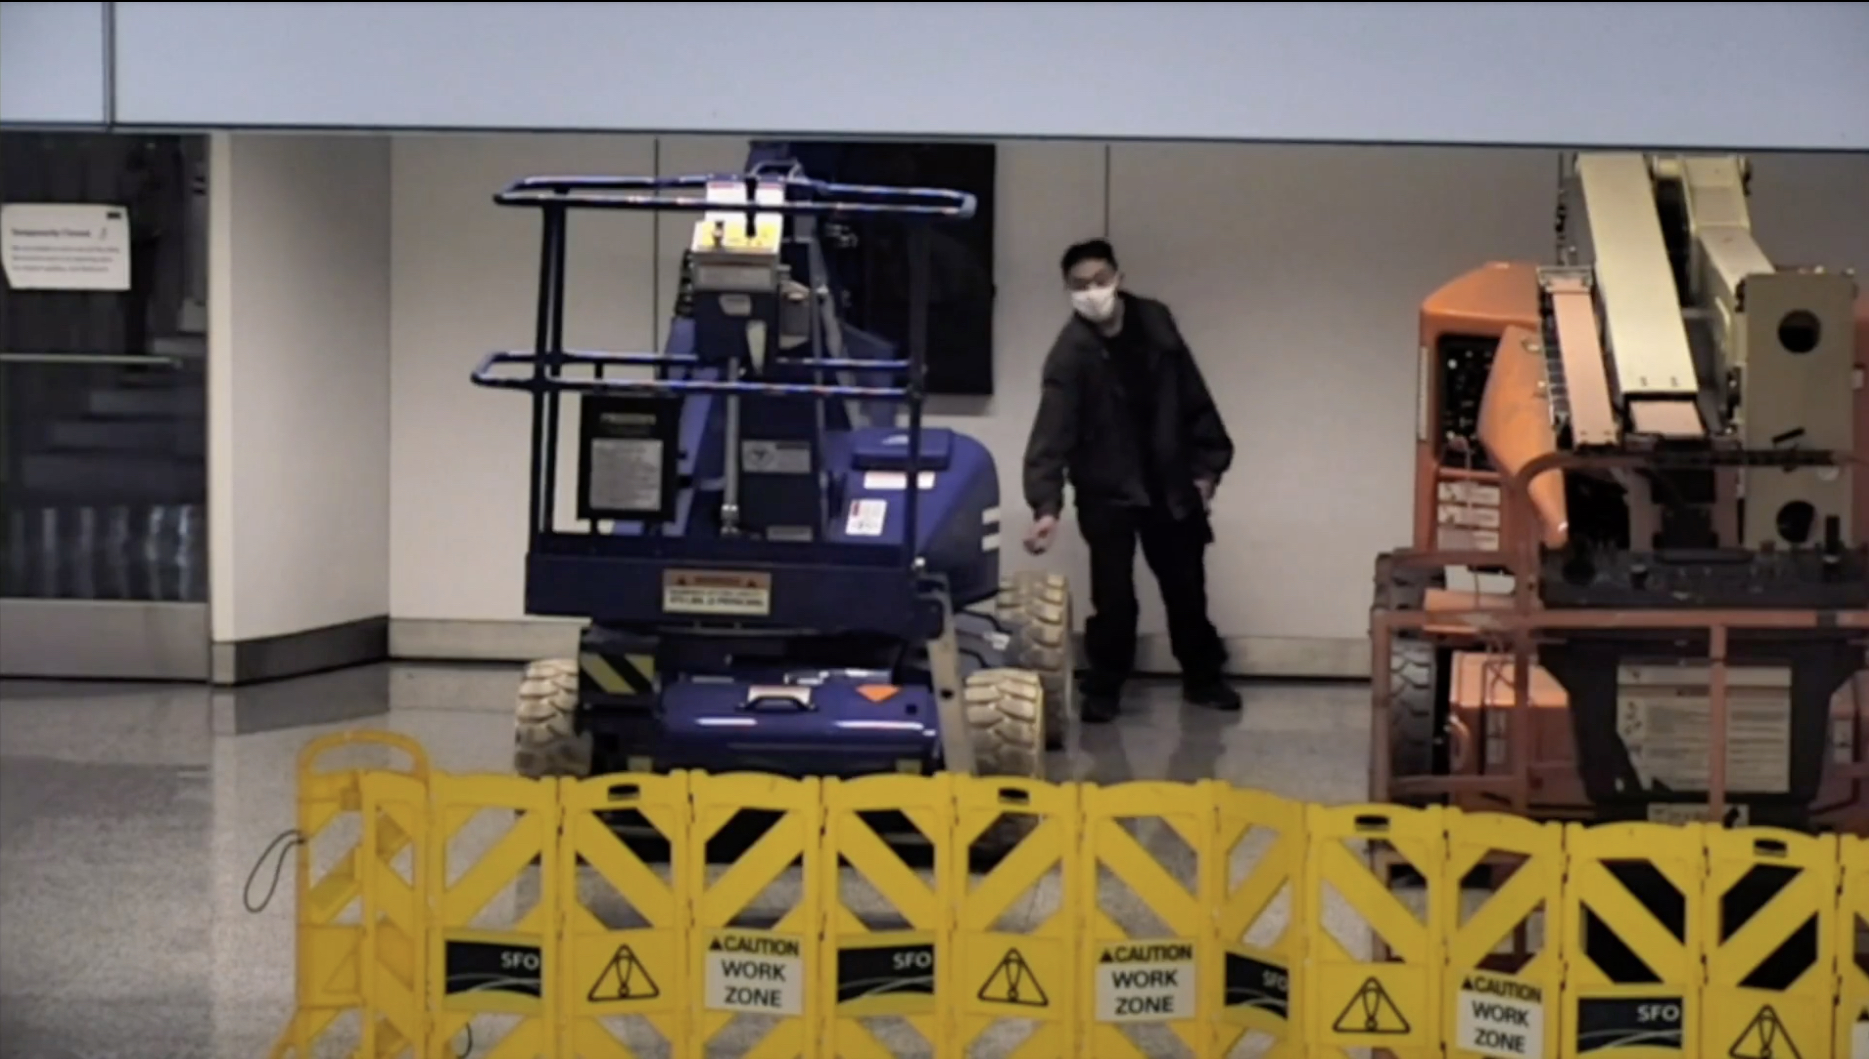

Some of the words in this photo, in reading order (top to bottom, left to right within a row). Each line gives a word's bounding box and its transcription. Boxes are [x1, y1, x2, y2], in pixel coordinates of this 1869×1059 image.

[724, 935, 799, 957] CAUTION
[1115, 943, 1192, 963] CAUTION
[500, 951, 539, 971] SFO
[721, 959, 786, 982] WORK
[893, 950, 932, 969] SFO
[1111, 969, 1178, 989] WORK
[1262, 969, 1287, 992] SFO
[1475, 976, 1542, 1004] CAUTION
[724, 985, 782, 1008] ZONE
[1114, 994, 1174, 1016] ZONE
[1472, 1000, 1529, 1028] WORK
[1637, 1004, 1680, 1022] SFO
[1474, 1027, 1525, 1054] ZONE
